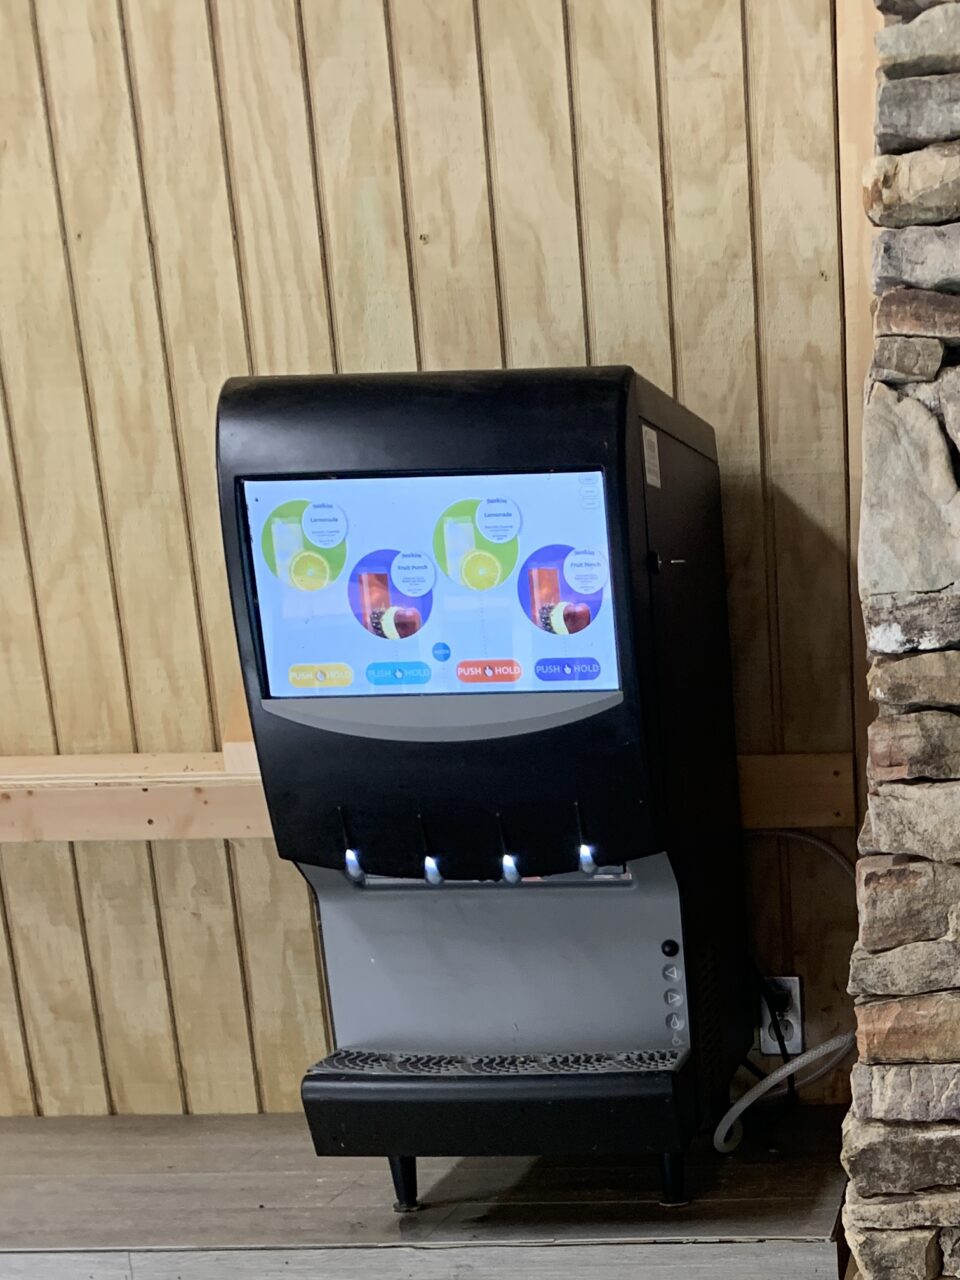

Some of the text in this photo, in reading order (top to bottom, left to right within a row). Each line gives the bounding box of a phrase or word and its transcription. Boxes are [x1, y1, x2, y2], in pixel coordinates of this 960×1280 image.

[367, 668, 430, 678] PUSH HOLD
[457, 665, 520, 676] PUSH HOLD
[536, 663, 599, 674] PUSH HOLD
[289, 670, 352, 681] PUSH HOLD
